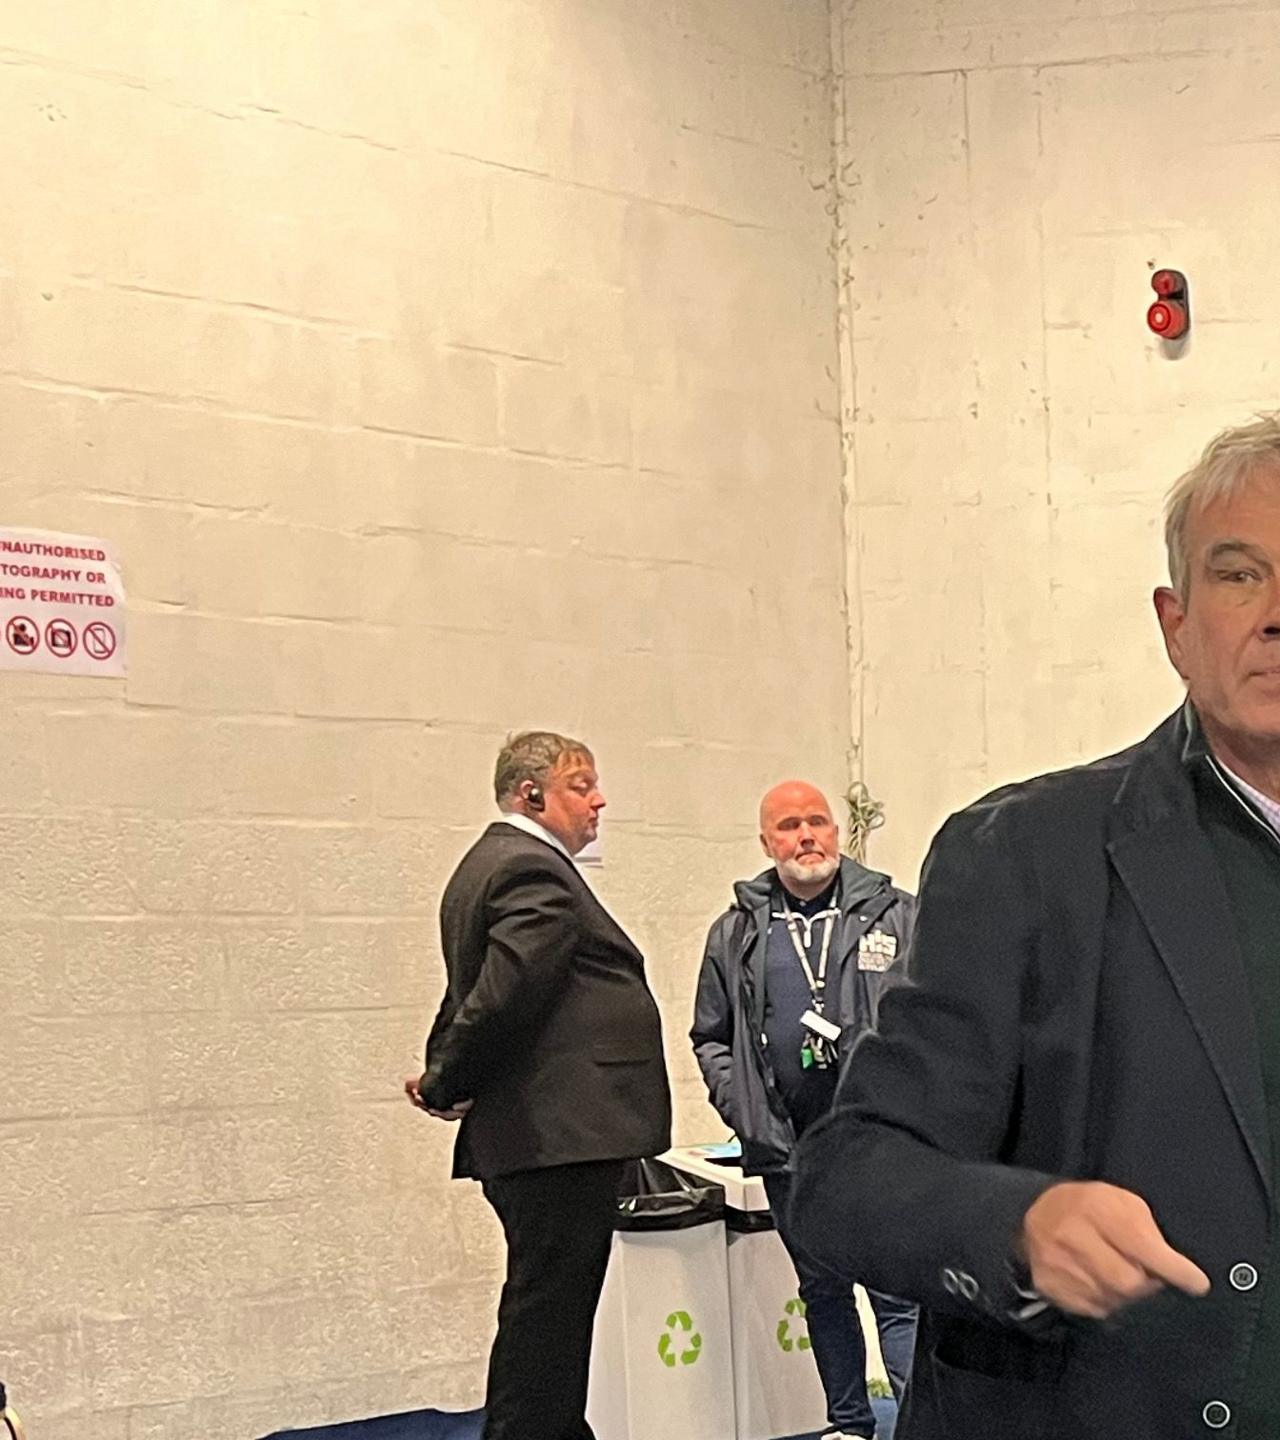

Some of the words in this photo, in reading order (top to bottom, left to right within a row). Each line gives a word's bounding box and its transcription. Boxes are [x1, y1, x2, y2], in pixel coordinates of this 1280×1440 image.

[0, 541, 106, 561] NAUTHORISED
[0, 563, 82, 582] TOGRAPHY
[86, 572, 106, 584] OR
[31, 589, 115, 607] PERMITTED
